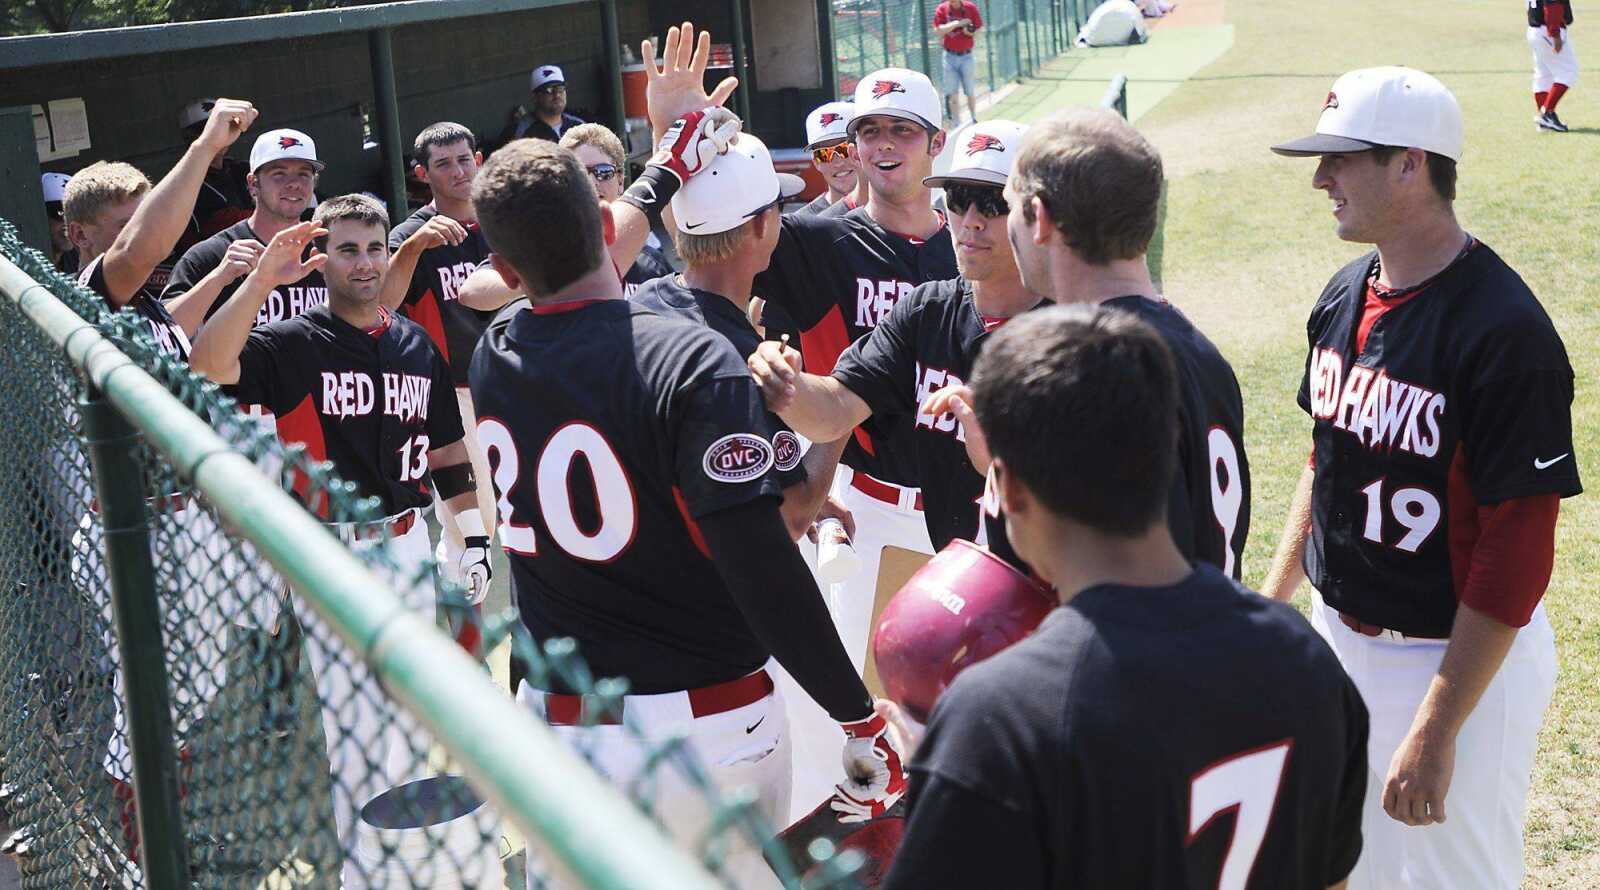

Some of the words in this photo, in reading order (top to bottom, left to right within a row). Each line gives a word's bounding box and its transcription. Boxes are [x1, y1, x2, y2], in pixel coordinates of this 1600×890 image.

[321, 371, 375, 424] RED
[1333, 363, 1446, 458] HAWKS
[398, 434, 430, 482] 13
[1362, 478, 1441, 552] 19
[1186, 738, 1294, 890] 7
